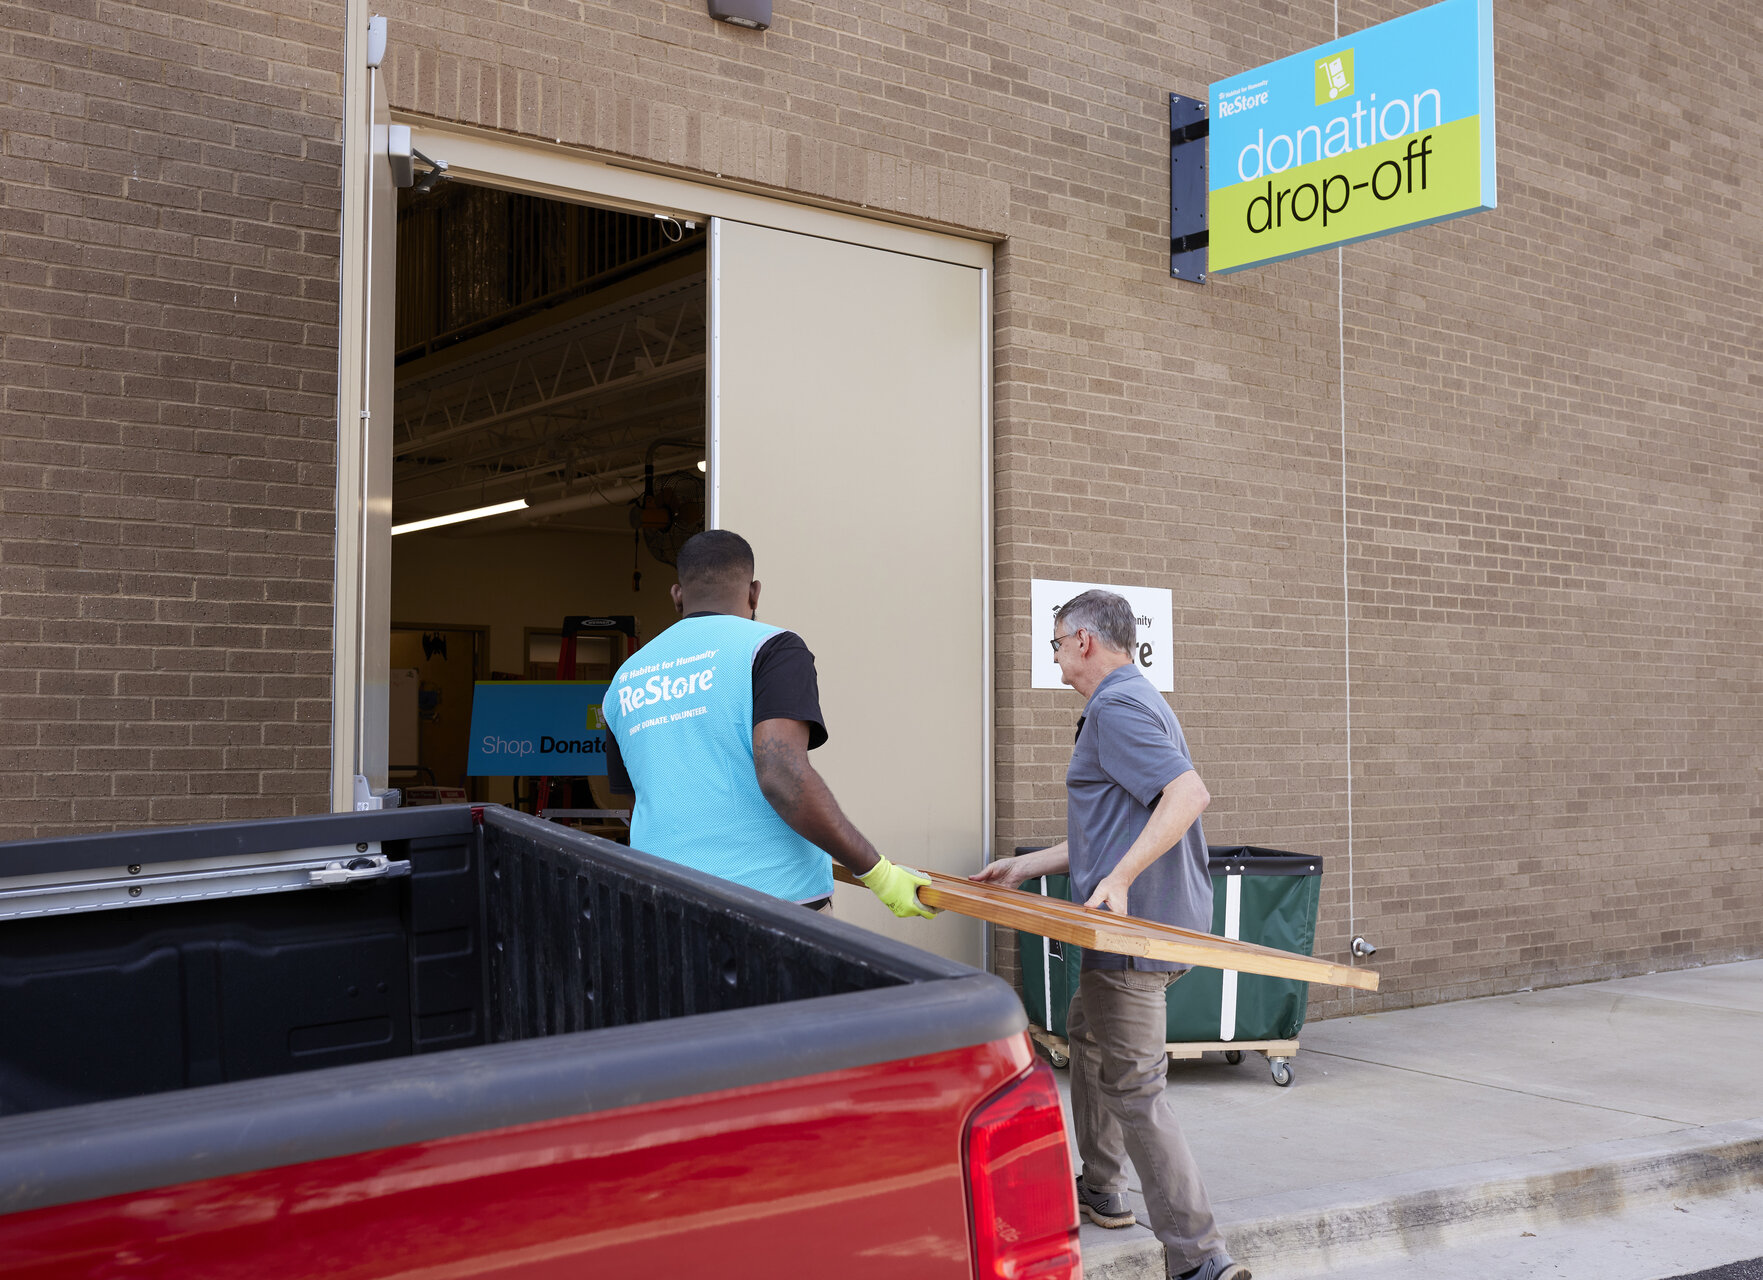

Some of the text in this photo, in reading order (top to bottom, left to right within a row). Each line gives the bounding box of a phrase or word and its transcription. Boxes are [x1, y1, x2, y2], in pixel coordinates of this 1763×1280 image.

[1219, 92, 1269, 118] ReStore
[1238, 88, 1441, 182] donation
[1246, 135, 1433, 234] drop-off
[629, 649, 717, 679] Habitat for Humanity
[618, 669, 713, 718] ReStore
[482, 736, 535, 758] Shop.
